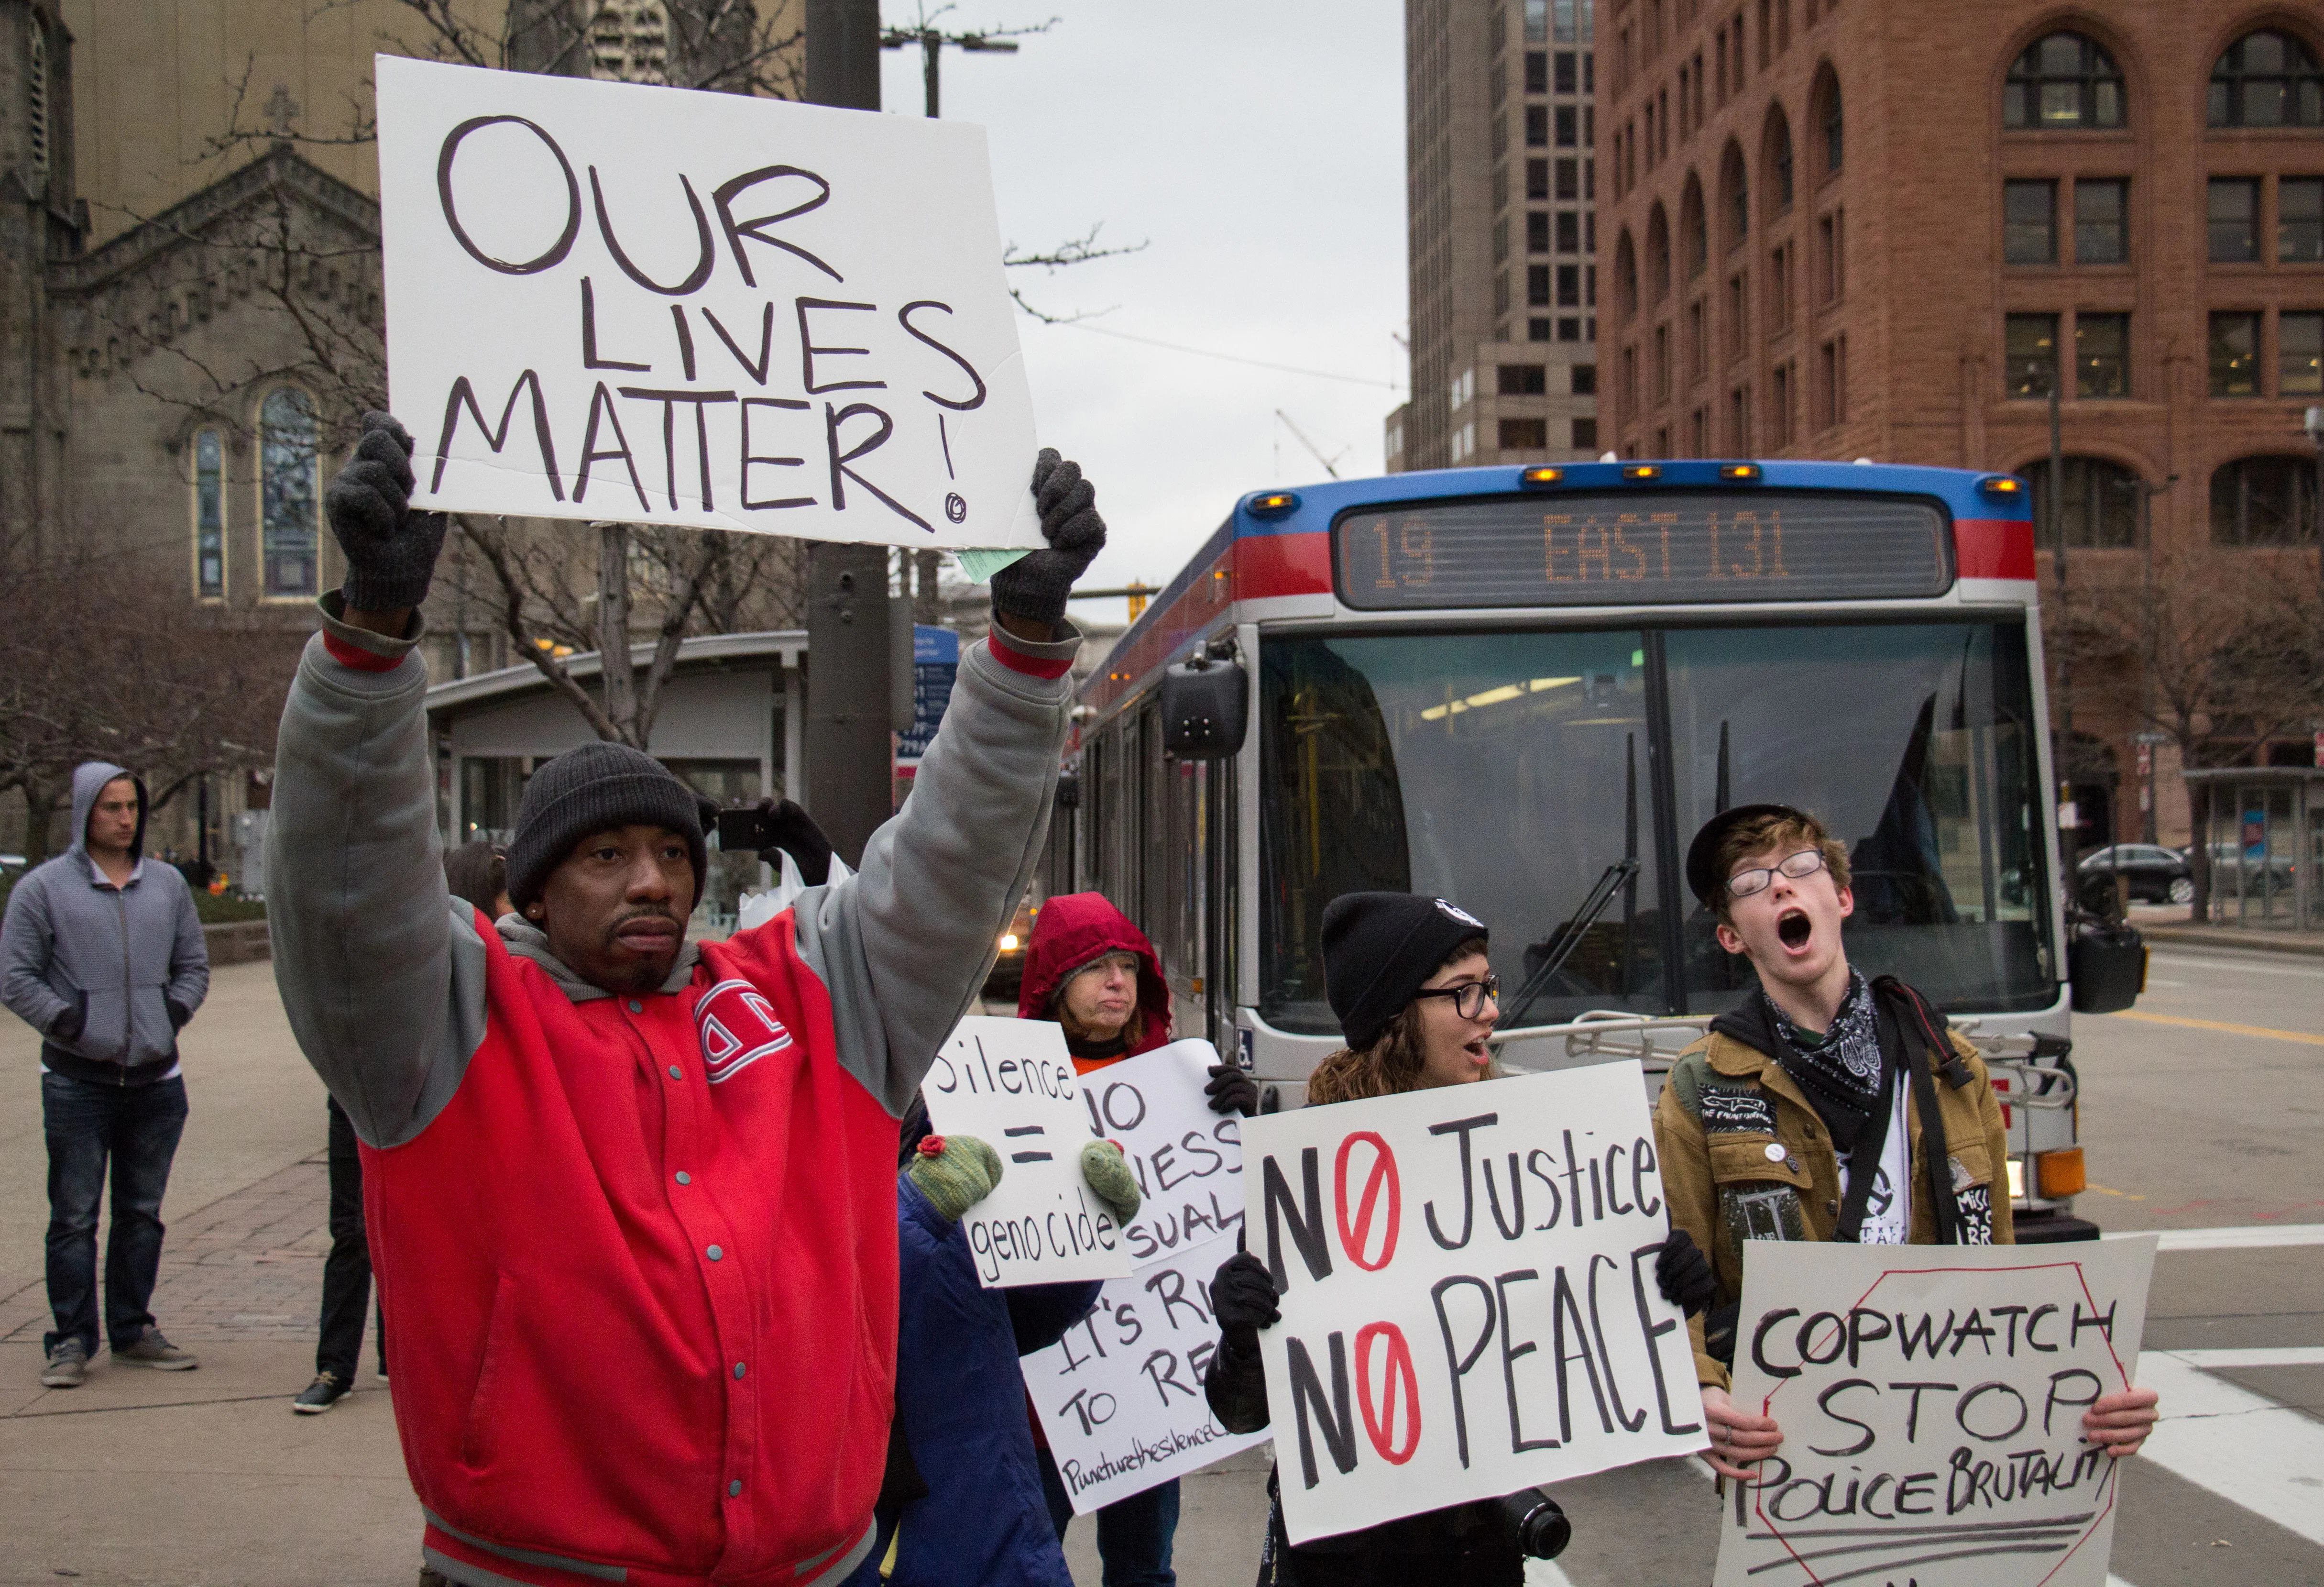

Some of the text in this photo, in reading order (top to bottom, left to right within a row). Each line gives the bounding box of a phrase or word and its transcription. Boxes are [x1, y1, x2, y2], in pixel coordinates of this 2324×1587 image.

[438, 115, 843, 295] OUR
[581, 276, 986, 411] LIVES
[431, 369, 966, 533] MATTER!
[1373, 510, 1789, 588] 19 EAST 131
[971, 1186, 1116, 1282] genocide
[1430, 1242, 1702, 1470] PEACE
[1751, 1300, 2117, 1378] COPWATCH
[1059, 1388, 1116, 1435] TO
[1808, 1368, 2102, 1457] STOP
